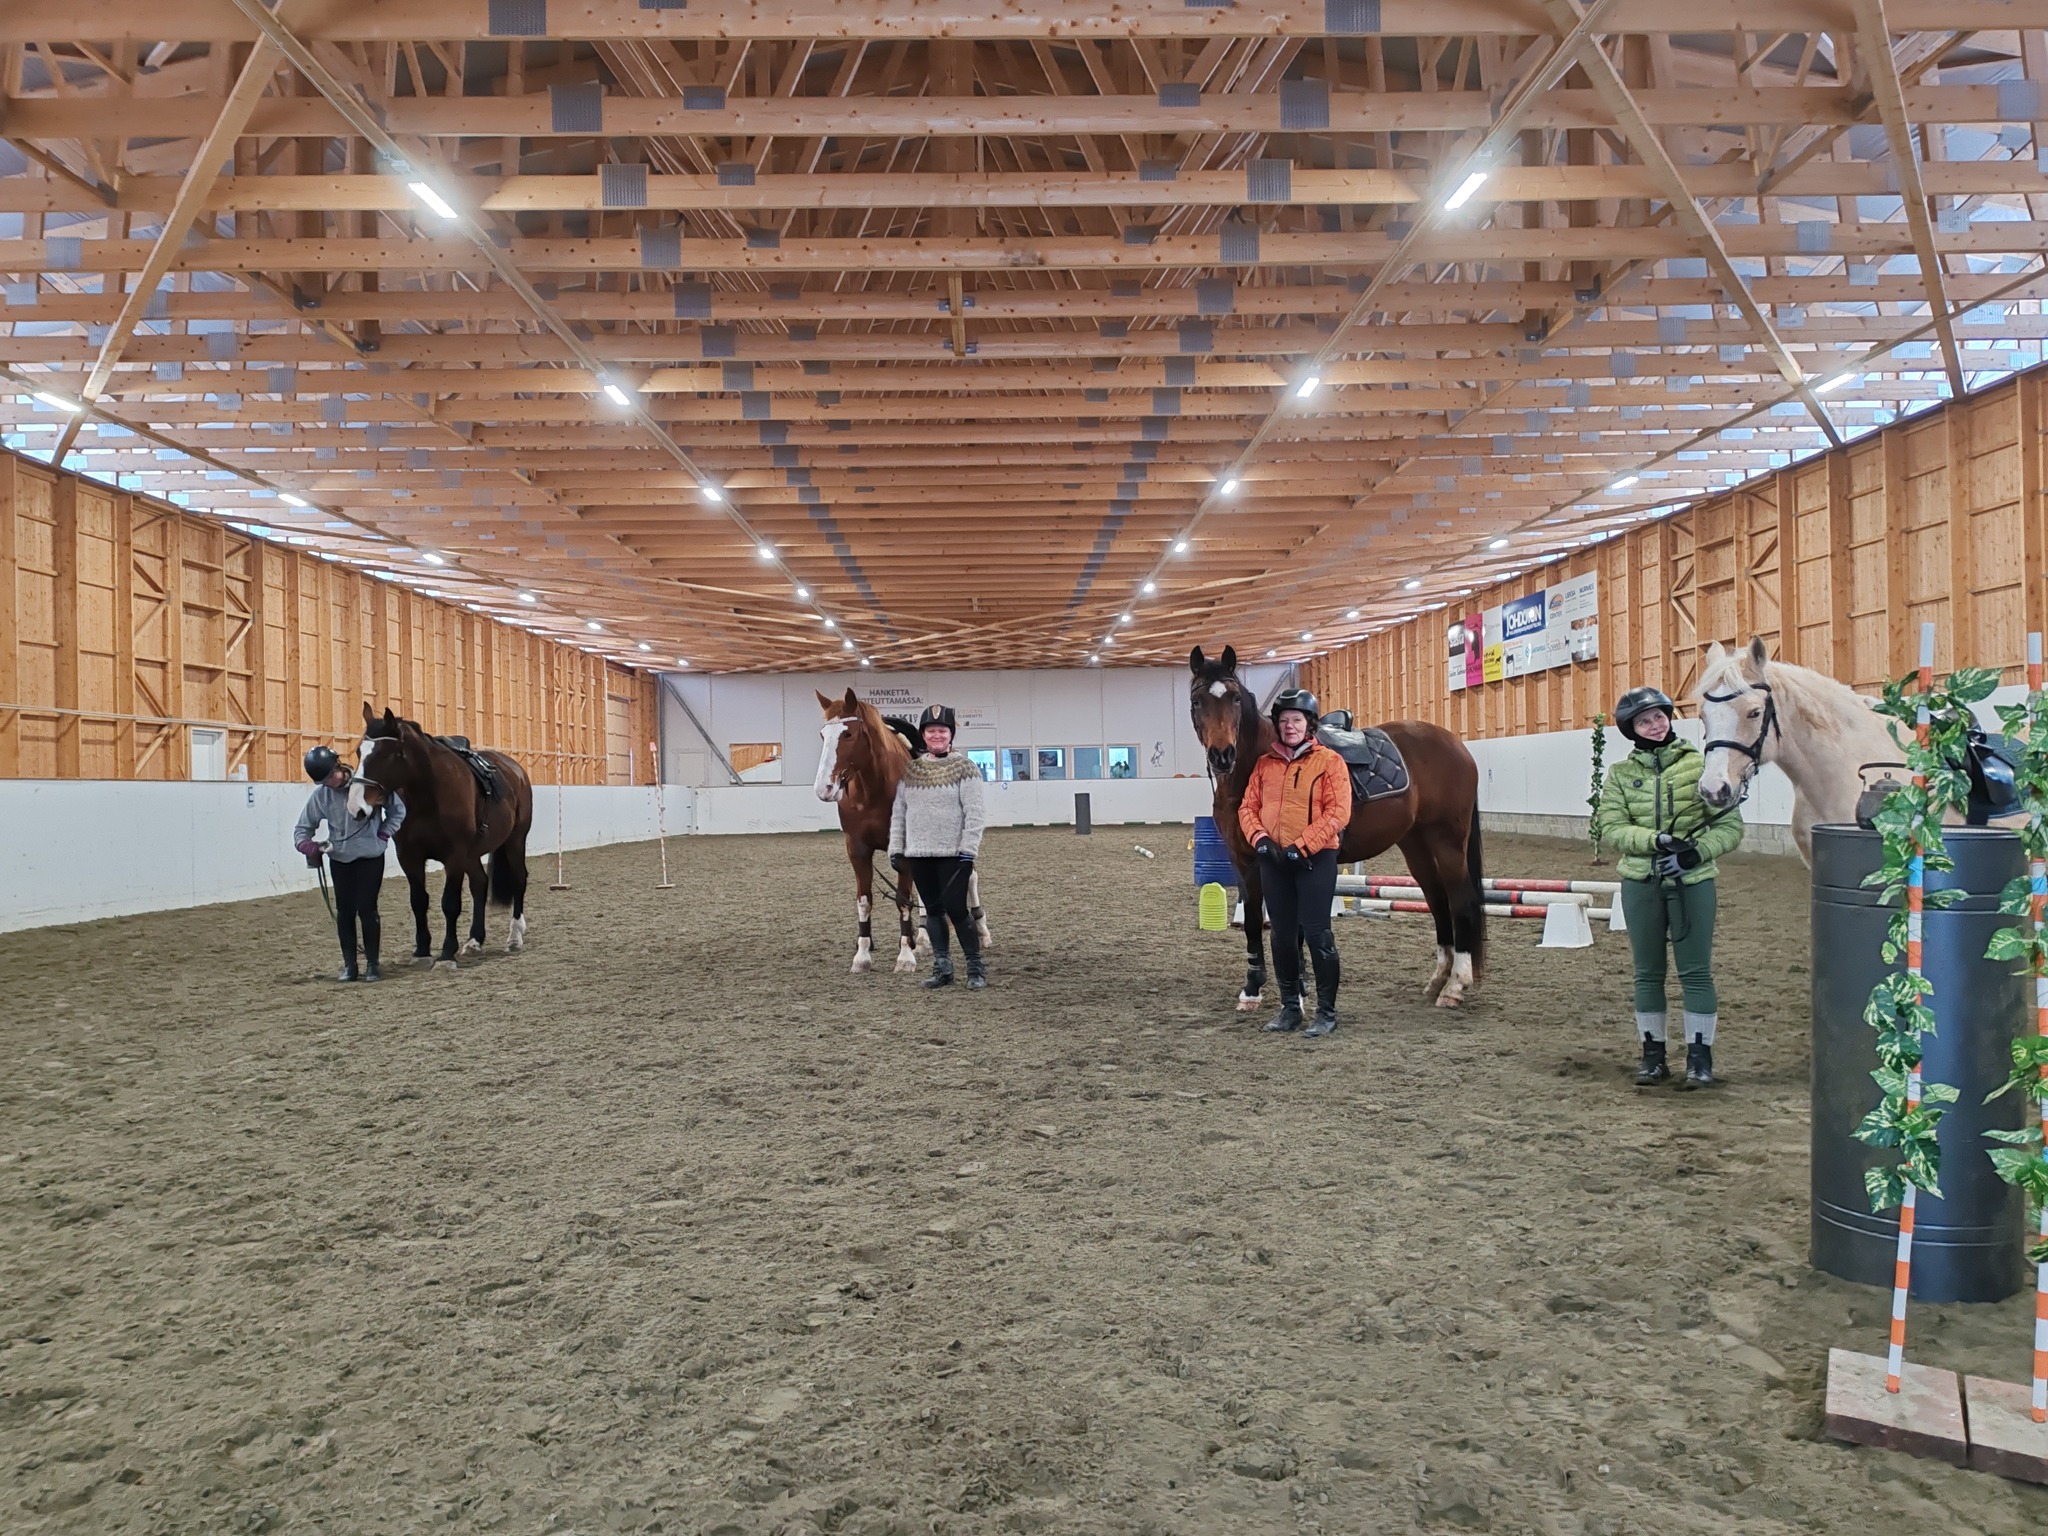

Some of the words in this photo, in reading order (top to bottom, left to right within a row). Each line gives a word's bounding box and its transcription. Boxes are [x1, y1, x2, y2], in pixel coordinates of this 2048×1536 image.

[859, 697, 924, 705] OTEUTTAMASSA:
[1002, 782, 1007, 790] C
[248, 786, 254, 803] E
